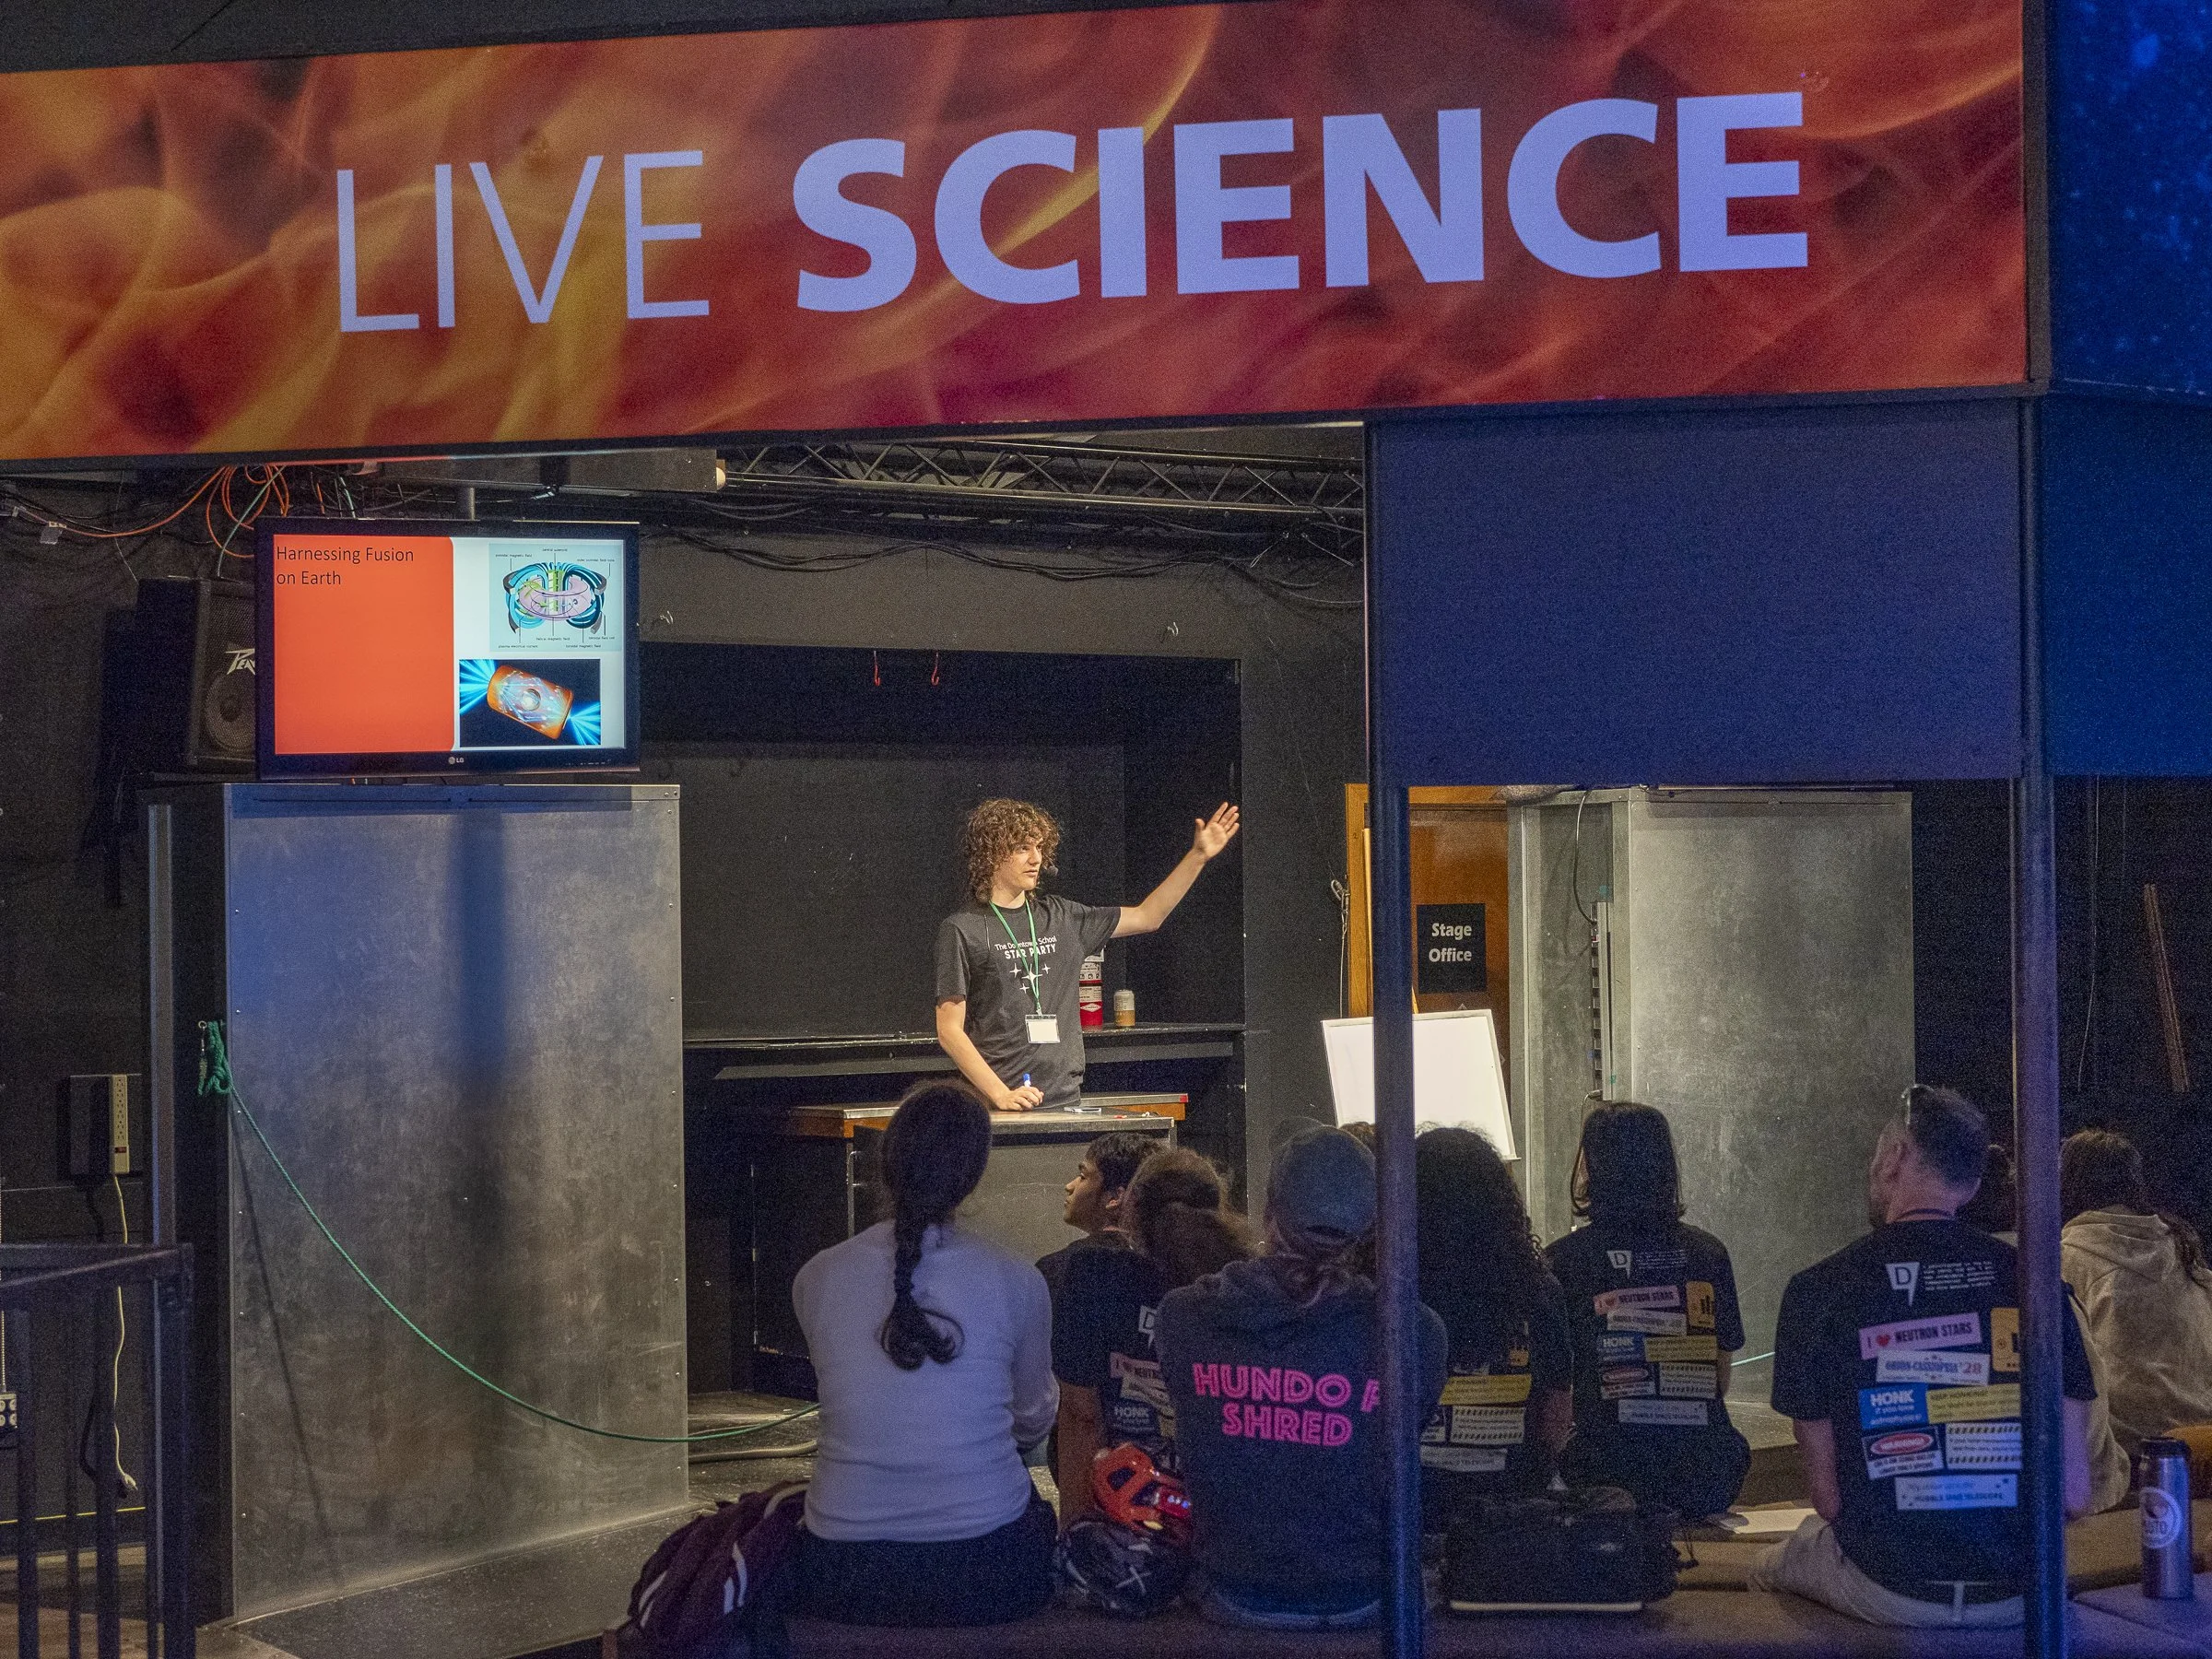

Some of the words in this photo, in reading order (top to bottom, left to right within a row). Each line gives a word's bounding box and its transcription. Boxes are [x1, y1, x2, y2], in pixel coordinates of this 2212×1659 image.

[336, 149, 711, 333] LIVE
[793, 90, 1809, 313] SCIENCE
[276, 546, 361, 565] Harnessing
[365, 547, 415, 562] Fusion
[276, 572, 296, 585] on
[301, 570, 342, 585] Earth
[1431, 923, 1473, 940] Stage
[994, 943, 1008, 951] The
[1038, 935, 1058, 946] School
[1004, 949, 1028, 959] STAR
[1029, 944, 1056, 957] PARTY
[1429, 947, 1473, 962] Office
[1614, 1252, 1629, 1266] D
[1895, 1266, 1912, 1286] D
[1895, 1326, 1939, 1344] NEUTRON
[1940, 1322, 1973, 1338] STARS
[1192, 1362, 1352, 1408] HUNDO
[1869, 1389, 1915, 1407] HONK
[1113, 1406, 1150, 1418] HONK
[1222, 1402, 1353, 1447] SHRED
